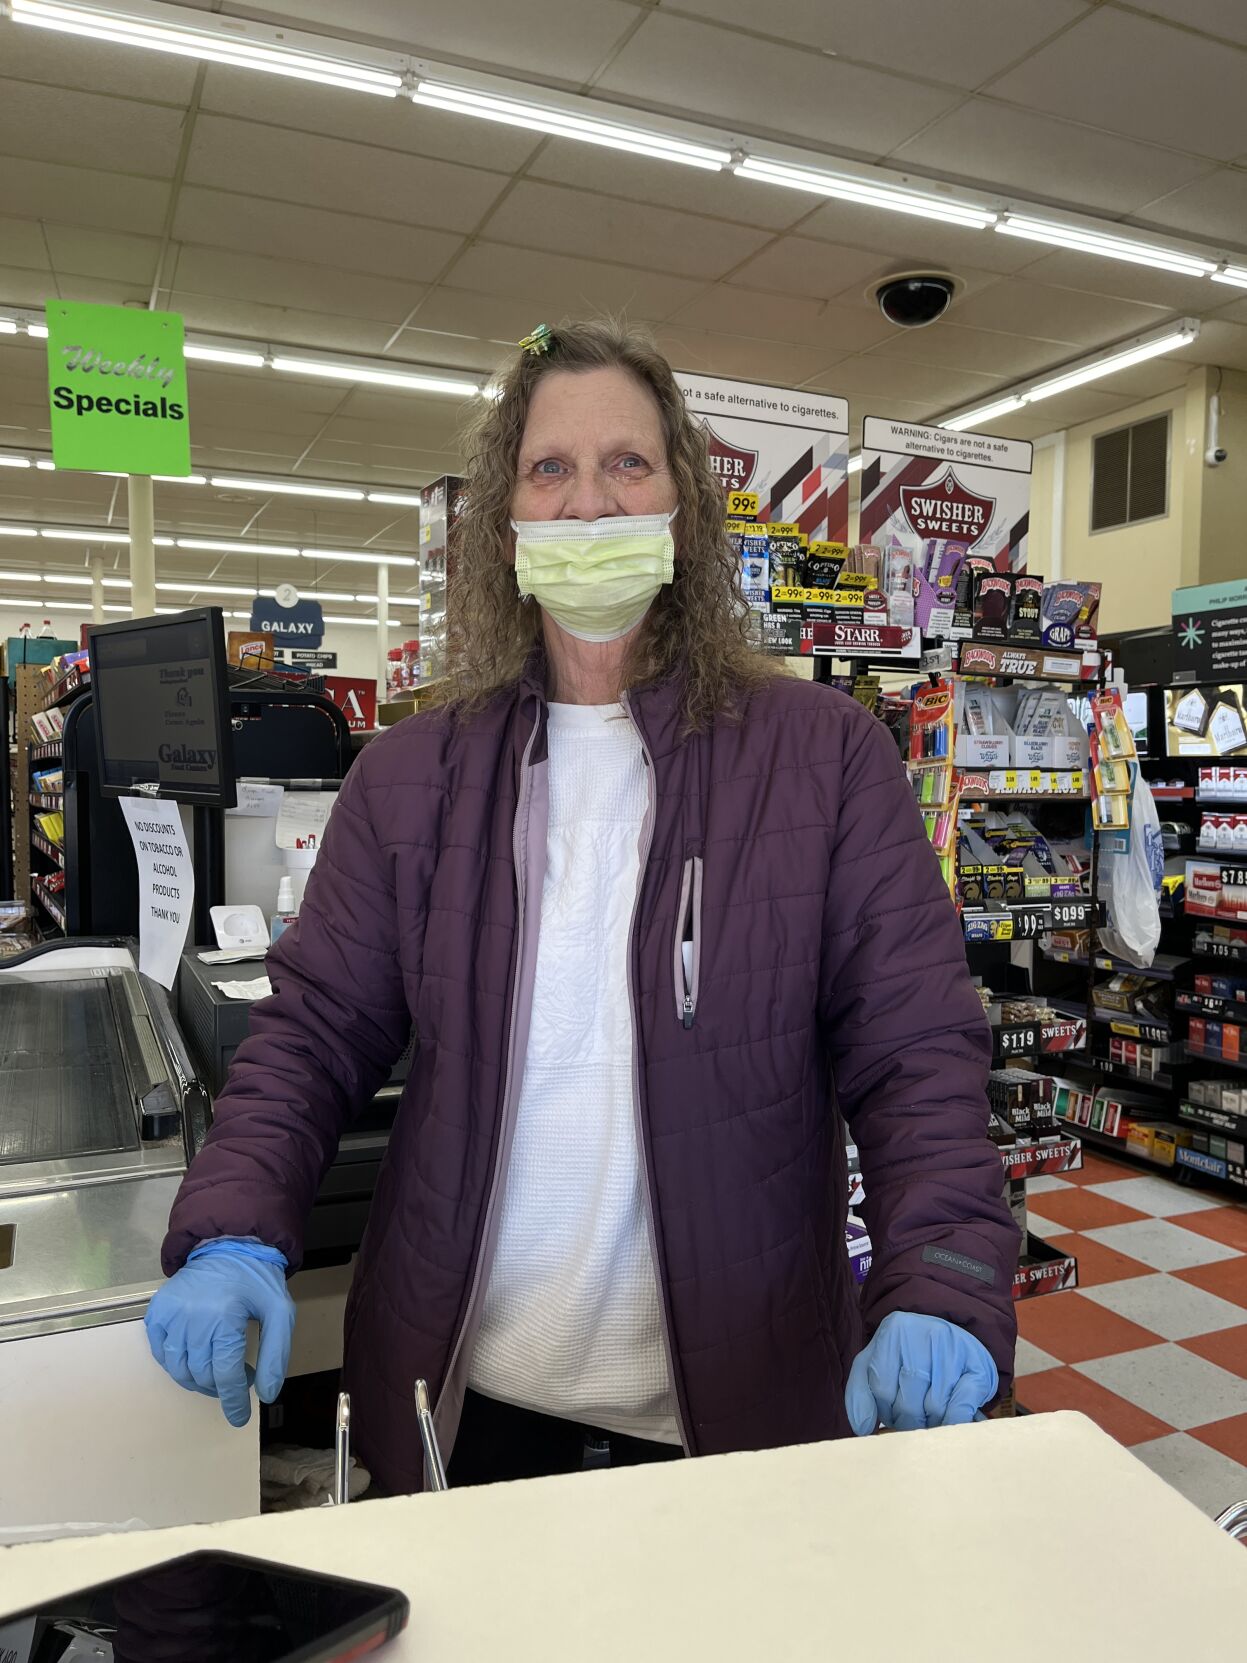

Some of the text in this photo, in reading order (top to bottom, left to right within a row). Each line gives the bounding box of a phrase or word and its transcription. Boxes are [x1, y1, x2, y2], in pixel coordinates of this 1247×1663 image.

[62, 344, 177, 389] Weekly
[53, 386, 185, 421] Specials
[683, 388, 692, 397] ot
[704, 390, 725, 402] safe
[727, 393, 778, 410] alternative
[780, 402, 790, 412] to
[792, 404, 839, 420] cigarettes.
[891, 425, 932, 441] WARNING:
[933, 432, 958, 445] Cigars
[959, 438, 972, 447] are
[973, 439, 985, 449] not
[993, 443, 1009, 453] safe
[905, 442, 994, 463] alternative to cigarettes.
[709, 455, 746, 477] HER
[719, 477, 740, 489] TS
[732, 497, 756, 512] 99¢
[911, 496, 985, 524] SWISHER
[771, 526, 776, 534] 2
[916, 518, 979, 536] SWEETS
[283, 588, 292, 601] 2
[774, 588, 781, 598] 2
[805, 591, 812, 600] 2
[835, 593, 842, 602] 2
[848, 593, 862, 603] 99¢
[763, 613, 787, 623] GREEN
[1018, 607, 1039, 619] STOUT
[261, 621, 314, 634] GALAXY
[834, 625, 880, 642] STARR
[1050, 627, 1071, 642] GRAPE
[778, 637, 793, 645] LOOK
[1002, 651, 1026, 660] ALWAYS
[1000, 658, 1038, 675] TRUE
[925, 694, 948, 706] BIC
[348, 720, 366, 729] UM
[158, 743, 216, 770] Galaxy
[134, 821, 176, 836] NO DISCOUNTS
[139, 840, 184, 858] ON TOBACCO OR
[153, 863, 178, 878] ALCOHOL
[152, 883, 180, 900] PRODUCTS
[151, 906, 180, 924] THANK YOU
[967, 921, 988, 932] ZIG-ZAG
[1002, 1030, 1034, 1049] $1.19
[1041, 1025, 1077, 1039] SWEETS
[1012, 1107, 1030, 1116] Black
[1033, 1102, 1051, 1111] Black
[1037, 1109, 1052, 1118] Mild
[1015, 1113, 1031, 1123] Mild
[1036, 1146, 1071, 1161] SWEETS
[1013, 1264, 1065, 1285] ER SWEETS
